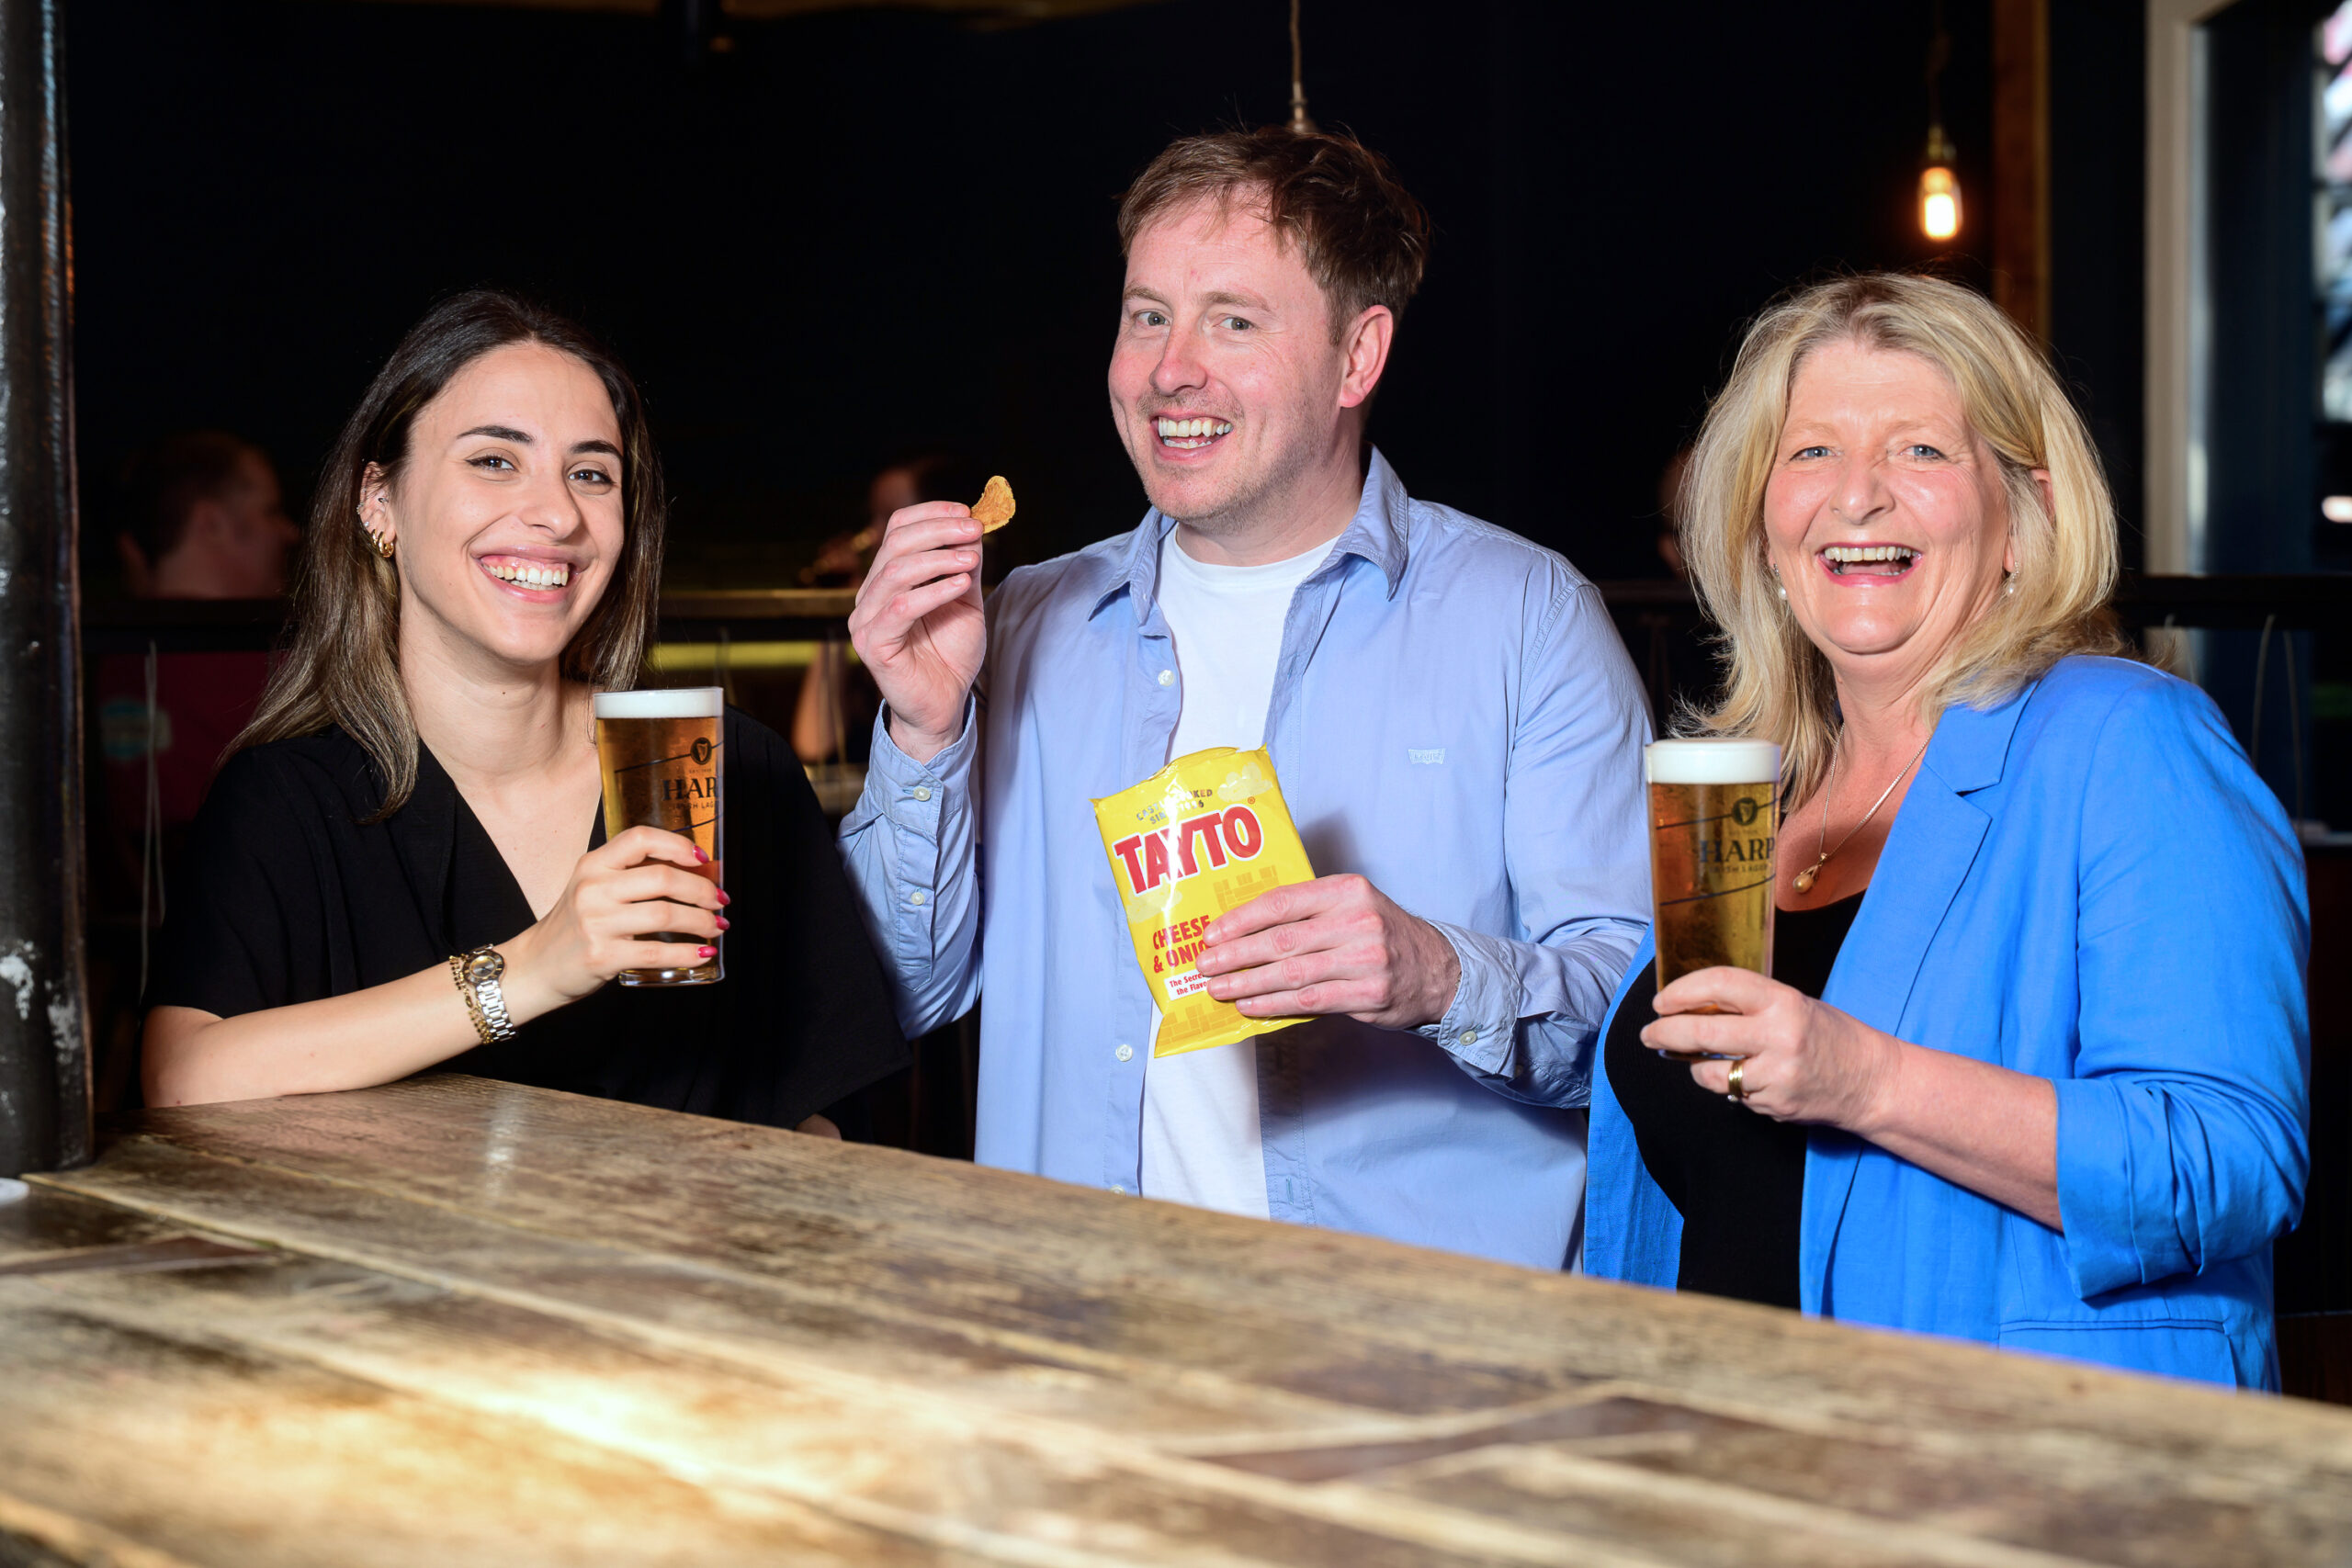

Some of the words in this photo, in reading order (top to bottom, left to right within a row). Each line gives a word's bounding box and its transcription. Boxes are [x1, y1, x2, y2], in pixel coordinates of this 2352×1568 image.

[1113, 805, 1262, 896] TAYTO
[1700, 837, 1775, 863] HARP
[1153, 955, 1164, 974] &
[1166, 940, 1209, 967] ONIO
[1169, 979, 1182, 988] The
[1183, 973, 1204, 984] Secre
[1176, 987, 1189, 996] the
[1189, 981, 1207, 991] Flavo
